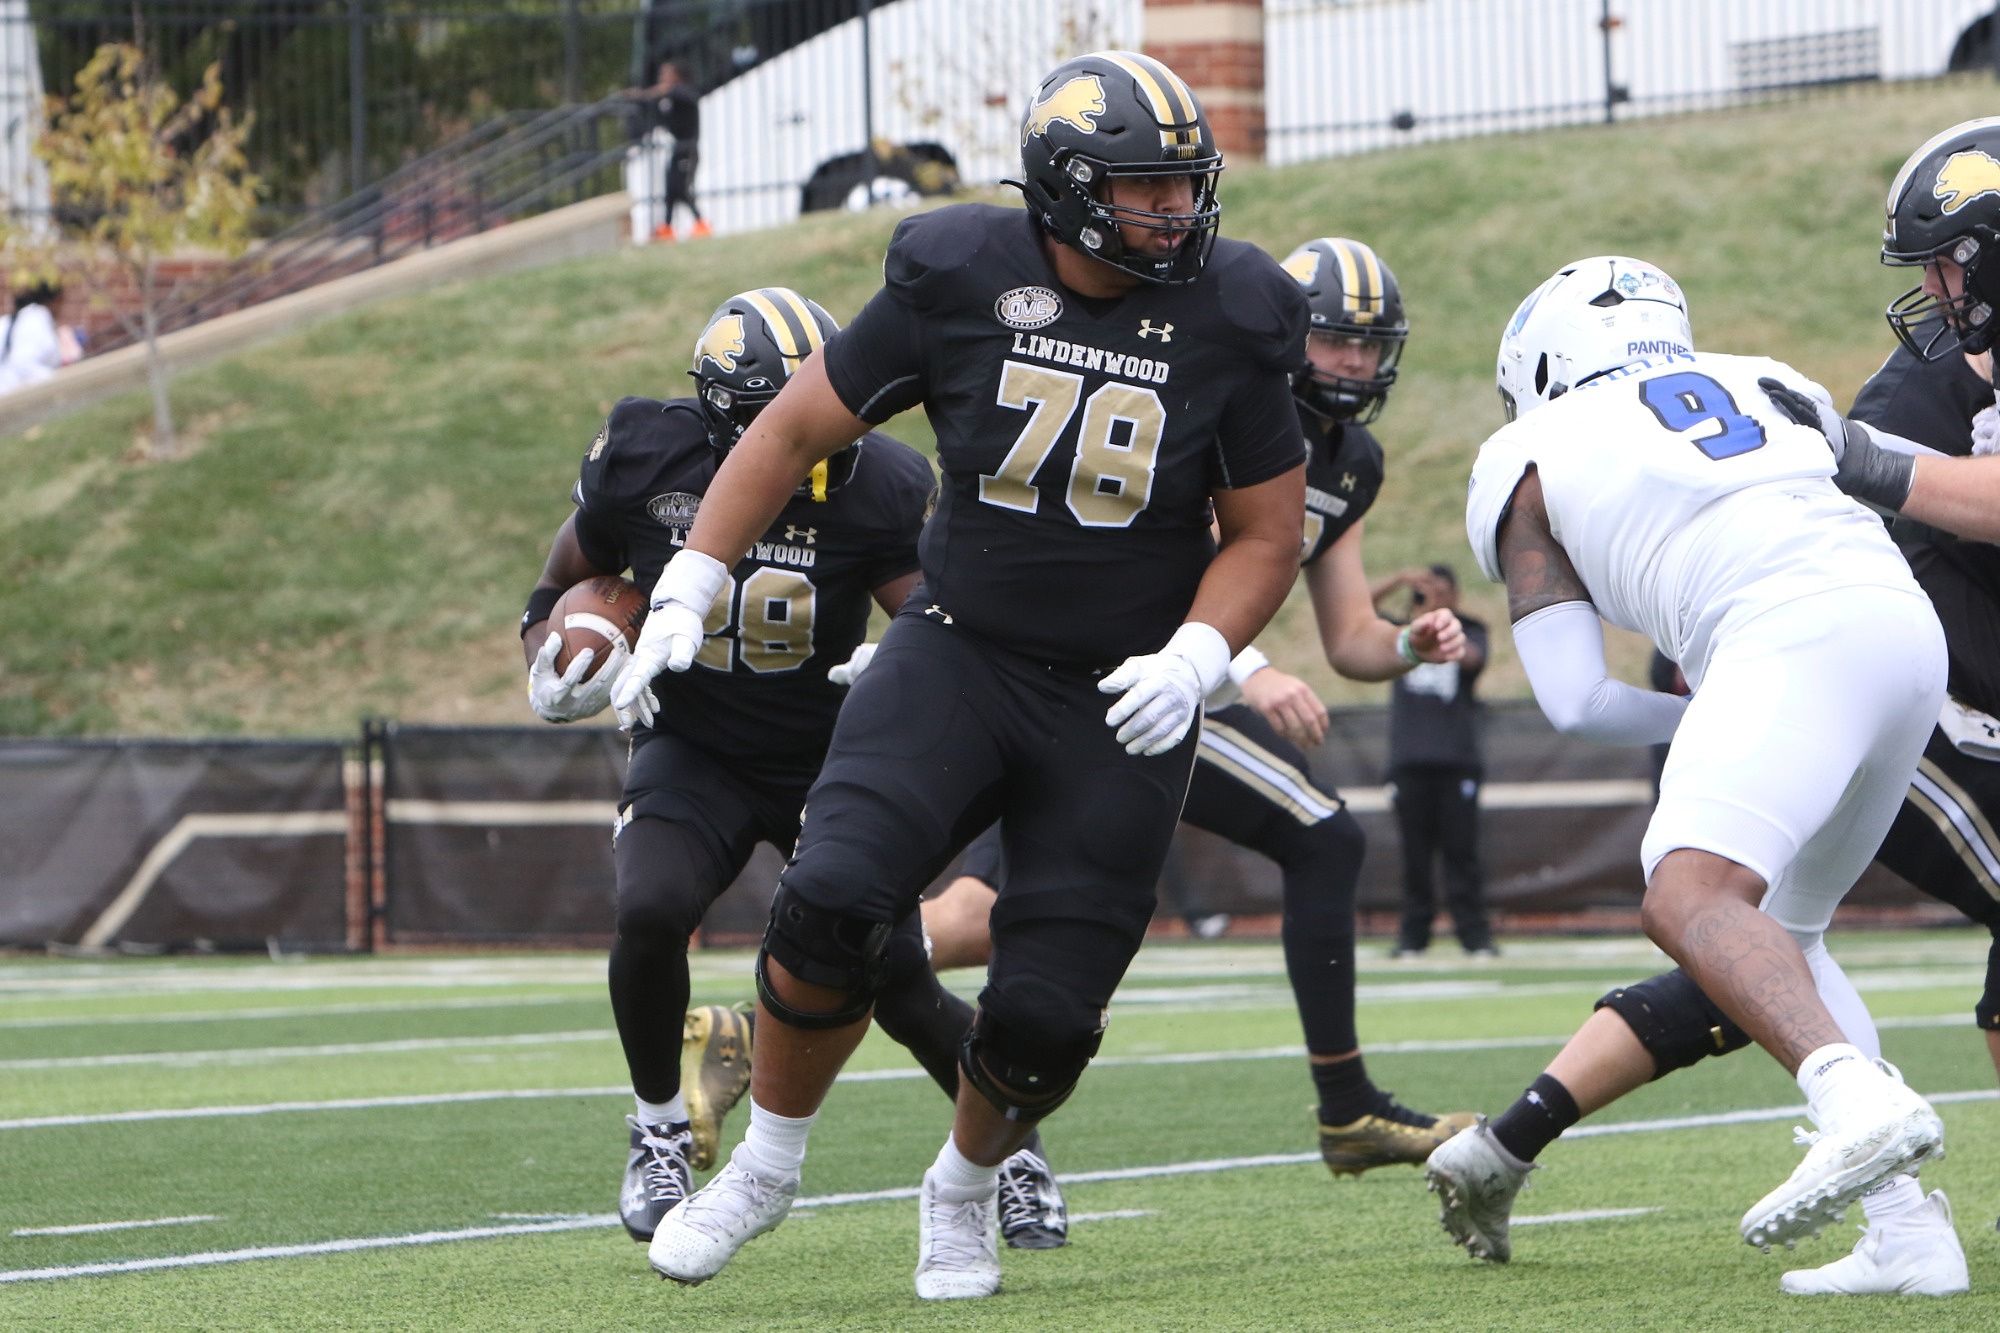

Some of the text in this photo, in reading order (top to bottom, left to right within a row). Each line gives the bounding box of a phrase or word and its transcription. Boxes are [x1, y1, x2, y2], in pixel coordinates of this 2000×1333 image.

[1009, 299, 1049, 318] OVC
[1012, 333, 1169, 384] LINDENWOOD
[1639, 371, 1767, 461] 9
[979, 360, 1166, 527] 78
[660, 504, 696, 518] OVC
